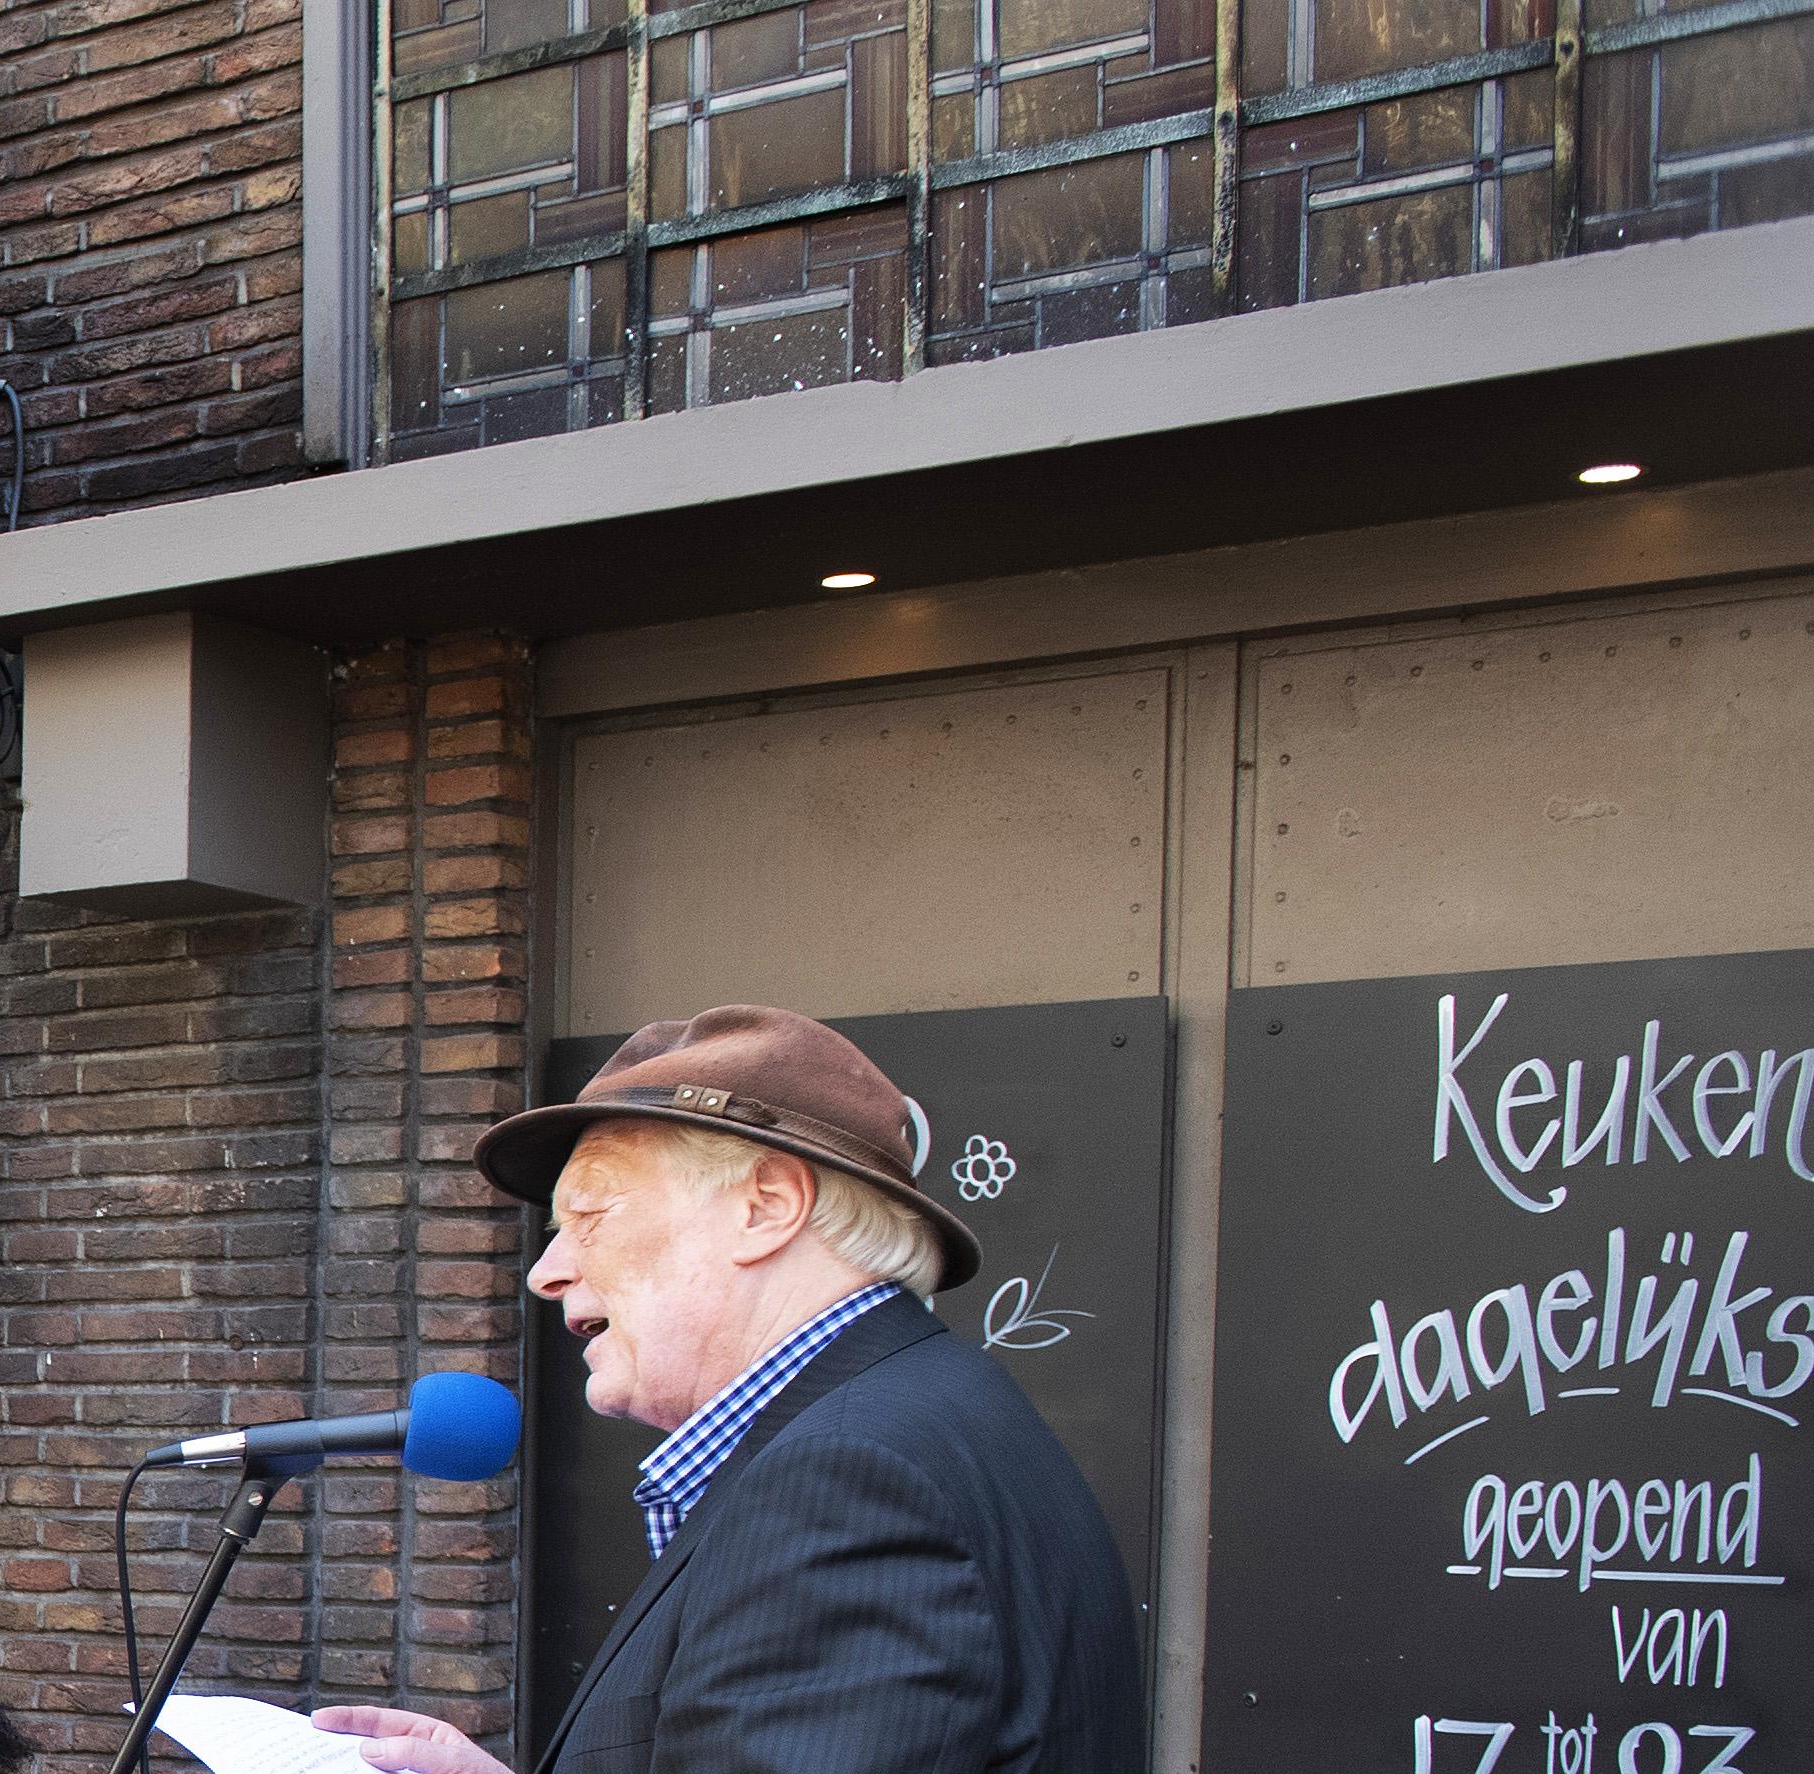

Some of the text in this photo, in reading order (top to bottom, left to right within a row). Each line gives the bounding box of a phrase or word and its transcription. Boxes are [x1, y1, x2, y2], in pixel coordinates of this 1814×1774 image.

[1433, 993, 1814, 1212] Keuken
[1329, 1227, 1814, 1442] dagelijks
[1463, 1453, 1762, 1591] geopend
[1612, 1605, 1727, 1689] van
